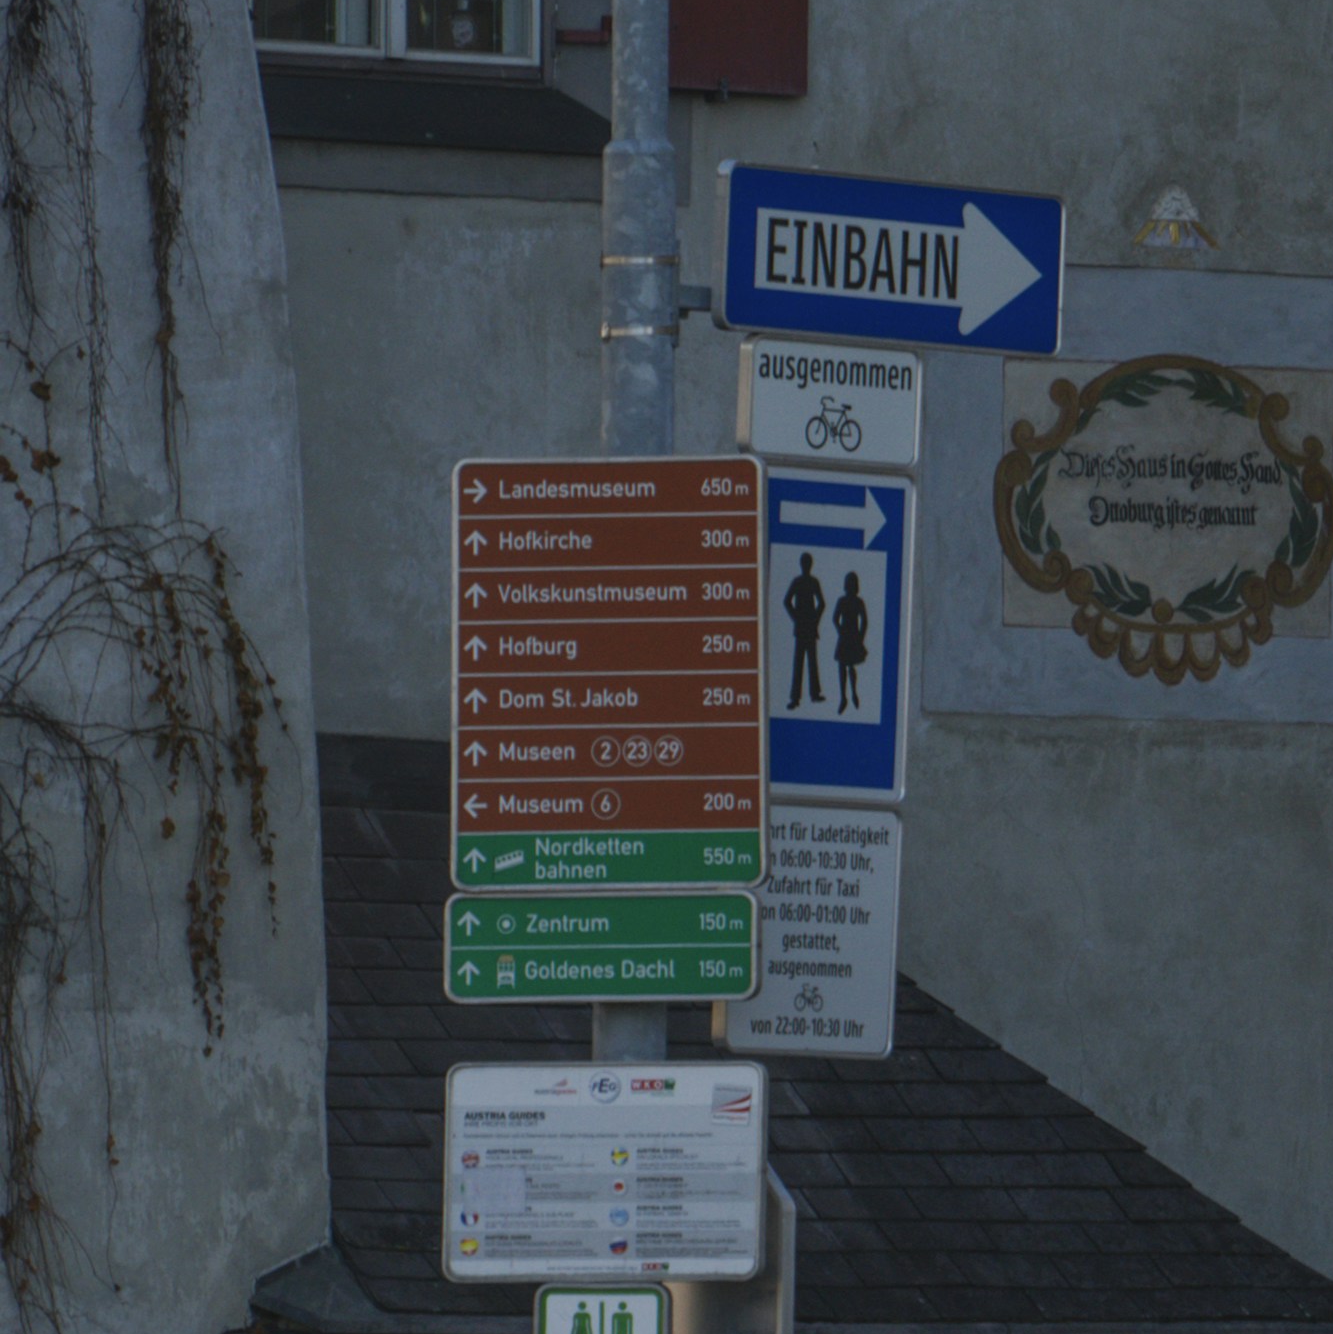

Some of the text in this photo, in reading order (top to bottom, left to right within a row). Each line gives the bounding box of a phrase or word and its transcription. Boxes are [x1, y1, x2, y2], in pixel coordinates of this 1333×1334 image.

[765, 217, 959, 300] EINBAHN
[759, 353, 913, 391] ausgenommen
[1116, 444, 1168, 488] Haus
[1171, 453, 1186, 480] in
[1188, 450, 1237, 491] Gottes
[498, 478, 749, 499] Landesmuseum 650 m
[1089, 496, 1165, 532] Ottoburg
[498, 530, 750, 551] Hofkirche 300 m
[498, 582, 750, 603] Volkskunstmuseum 300 m
[498, 634, 751, 660] Hofburg 250 m
[499, 687, 751, 708] Dom St. Jakob 250 m
[498, 740, 681, 762] Museen 2 23 29
[498, 793, 752, 815] Museum 6 200 m
[789, 824, 807, 841] für
[810, 824, 890, 848] Ladetätigkeit
[535, 837, 645, 857] Nordketten
[703, 847, 735, 866] 550
[737, 854, 752, 865] m
[779, 850, 847, 869] 06:00-10:30
[535, 859, 608, 880] bahnen
[766, 875, 861, 898] Zufahrt für Taxi
[525, 913, 743, 934] Zentrum 150 m
[760, 905, 871, 925] on 06:00-01:00 Uhr
[523, 958, 743, 981] Goldenes Dachl 150 m
[767, 960, 853, 980] ausgenommen
[750, 1017, 865, 1039] von 22:00-10:30 Uhr
